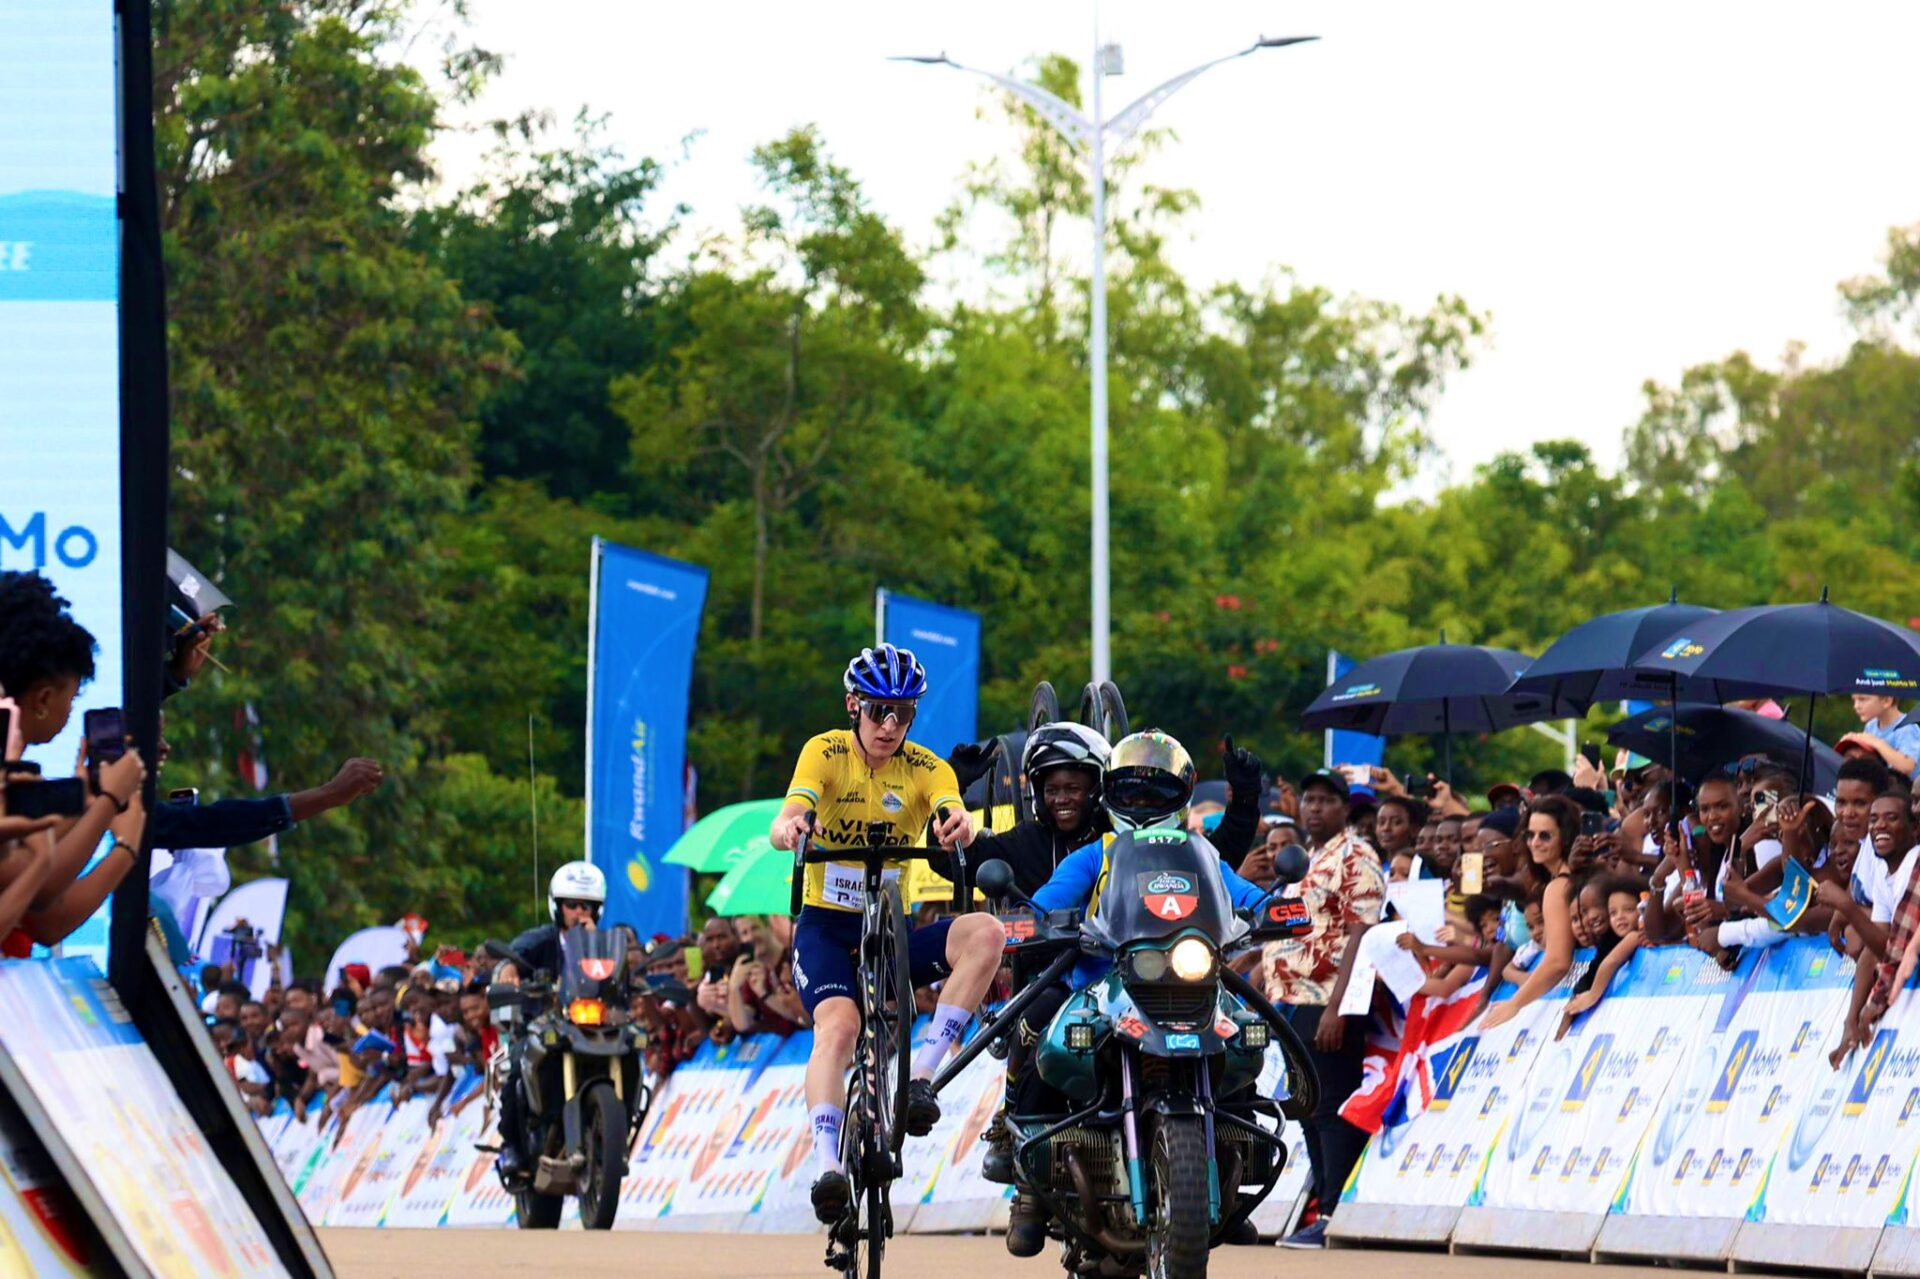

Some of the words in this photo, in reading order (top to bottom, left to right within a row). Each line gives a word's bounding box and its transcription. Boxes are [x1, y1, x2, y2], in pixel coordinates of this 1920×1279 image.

[840, 819, 896, 835] VIT
[1161, 896, 1182, 916] A
[1270, 903, 1308, 922] GS
[591, 959, 607, 977] A
